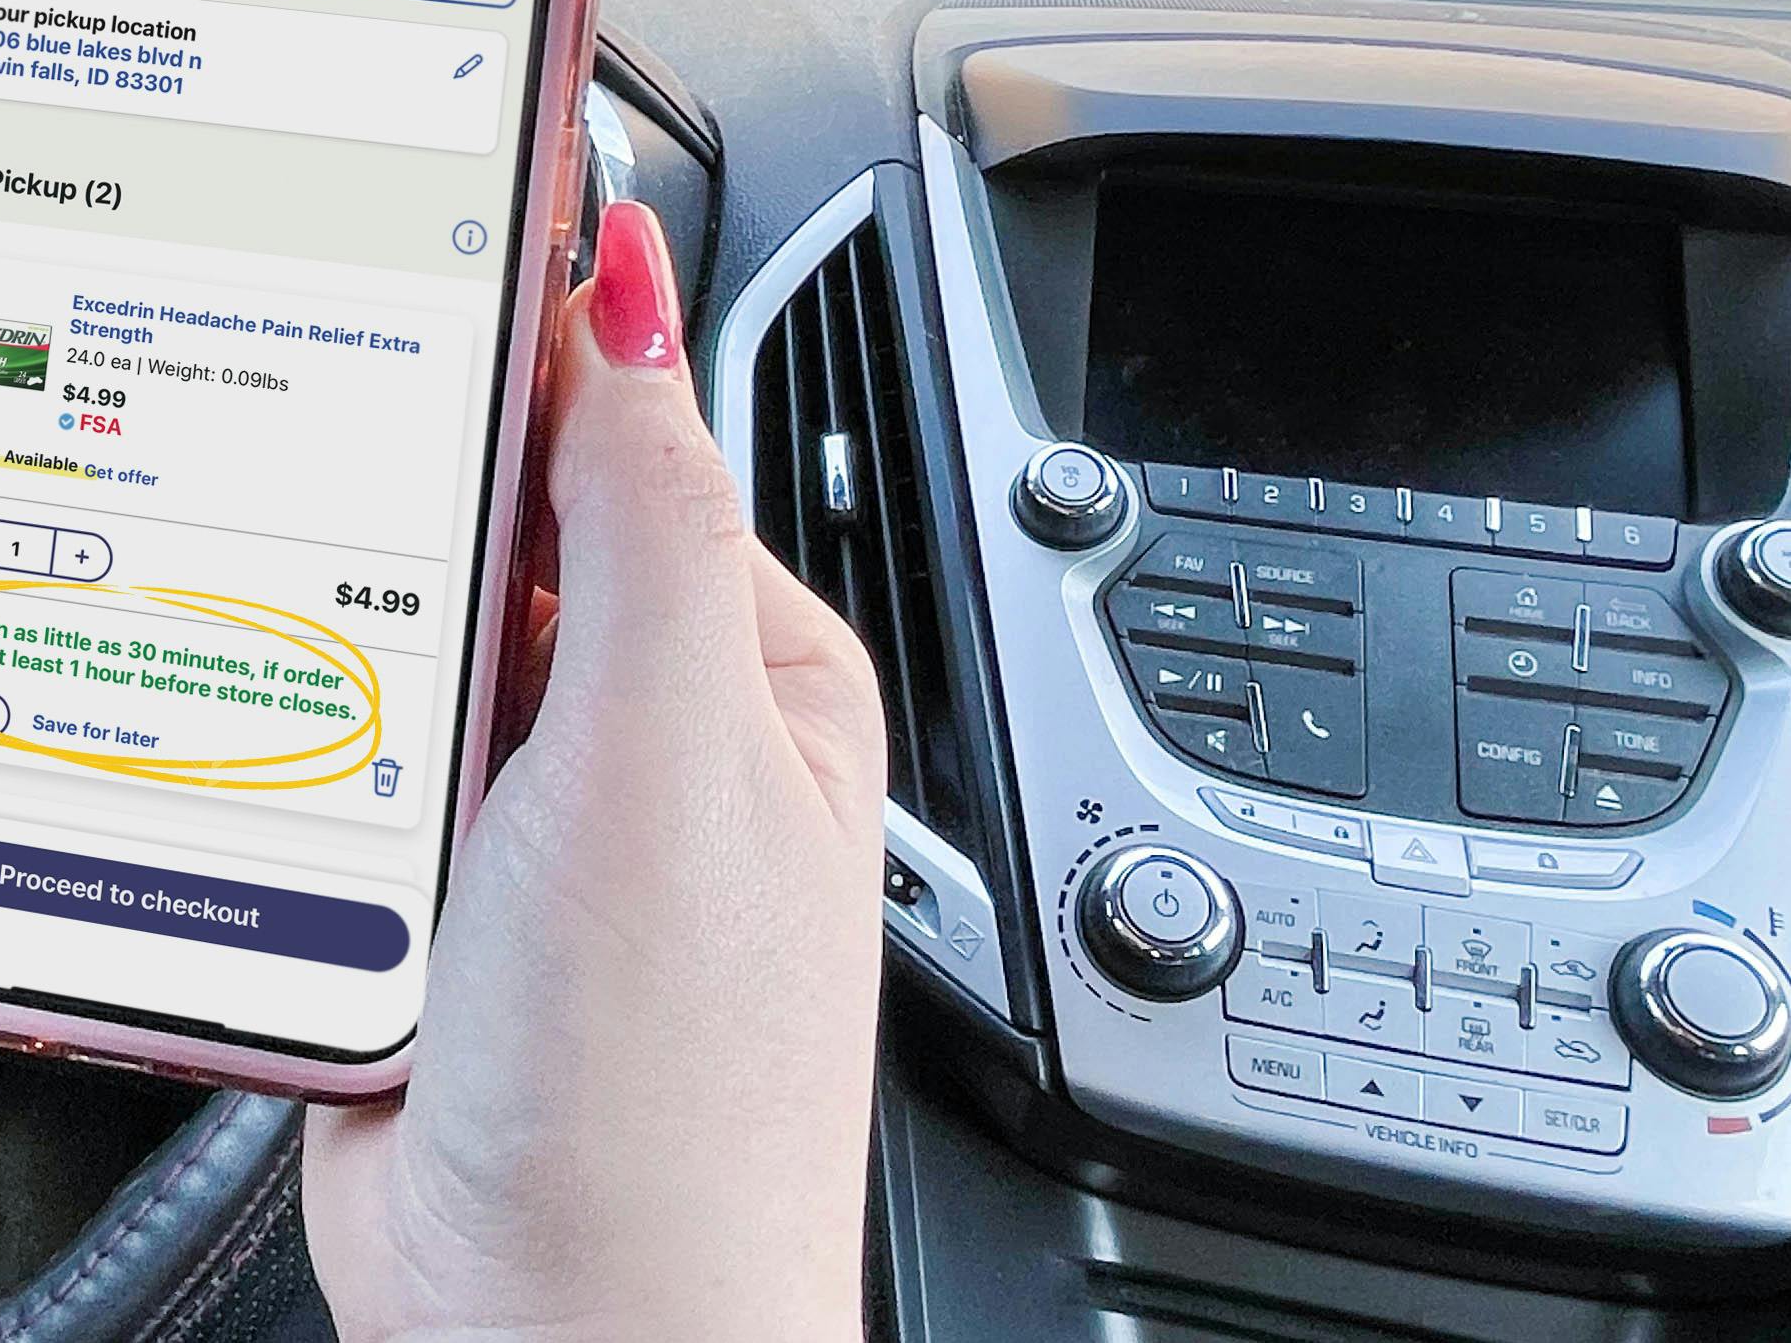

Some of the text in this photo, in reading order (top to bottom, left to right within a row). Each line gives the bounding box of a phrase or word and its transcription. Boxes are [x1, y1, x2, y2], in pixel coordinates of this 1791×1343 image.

[33, 7, 106, 35] pickup
[111, 15, 197, 42] location
[26, 32, 72, 55] blue
[77, 38, 132, 62] lakes
[137, 45, 184, 68] blvd
[188, 55, 202, 70] n
[30, 60, 80, 87] falls,
[87, 67, 110, 86] ID
[115, 70, 183, 95] 83301
[85, 179, 122, 211] (2)
[69, 318, 153, 345] Strength
[72, 294, 421, 355] Excedrin Headache Pain Relief Extra
[66, 347, 105, 367] 24.0
[110, 356, 132, 371] ea
[148, 358, 216, 382] Weight:
[221, 368, 289, 392] 0.09lbs
[62, 382, 126, 409] $4.99
[79, 413, 122, 436] FSA
[3, 449, 79, 473] Available
[84, 463, 114, 481] Get
[117, 469, 159, 487] offer
[1180, 478, 1366, 513] 1 2 3
[1436, 503, 1641, 546] 4 5 6
[11, 541, 20, 557] 1
[1175, 555, 1315, 584] FAV SOURCE
[335, 581, 420, 617] $4.99
[1605, 612, 1651, 630] BACK
[13, 627, 38, 644] as
[43, 626, 92, 652] little
[97, 640, 122, 656] as
[127, 640, 157, 662] 30
[162, 647, 256, 681] minutes,
[263, 659, 280, 680] if
[283, 668, 345, 690] order
[11, 649, 64, 675] least
[69, 659, 79, 678] 1
[85, 660, 136, 686] hour
[140, 669, 212, 698] before
[216, 684, 274, 708] store
[278, 692, 357, 721] closes.
[1633, 670, 1673, 688] INFO
[32, 714, 160, 749] Save for later
[1615, 730, 1660, 752] TONE
[1477, 741, 1542, 766] CONFIG
[109, 881, 135, 907] to
[139, 884, 261, 930] checkout
[1256, 909, 1296, 928] AUTO
[1456, 959, 1499, 976] FRONT
[1261, 988, 1293, 1008] A/C
[1459, 1036, 1495, 1054] REAR
[1251, 1057, 1302, 1080] MENU
[1544, 1109, 1601, 1134] SET/CLR
[1365, 1124, 1479, 1158] VEHICLE INFO
